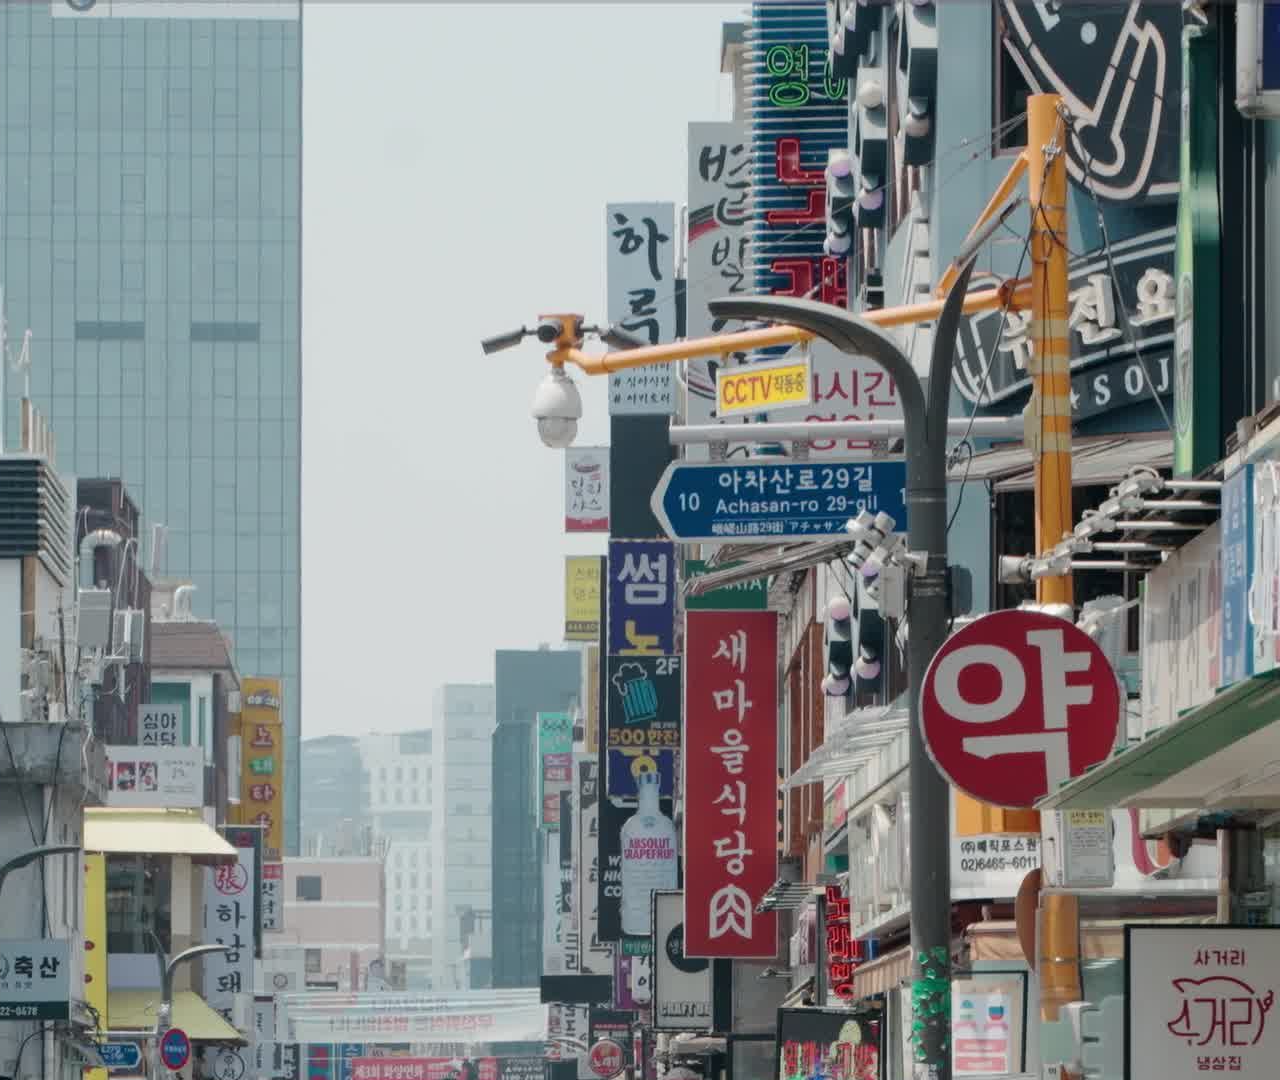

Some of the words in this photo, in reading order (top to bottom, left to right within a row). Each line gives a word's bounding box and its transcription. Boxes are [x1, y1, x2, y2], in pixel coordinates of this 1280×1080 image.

[723, 378, 772, 405] CCTV
[718, 465, 873, 494] 아차산로29길
[679, 492, 700, 512] 10
[715, 498, 819, 515] Achasan-ro
[826, 495, 878, 517] 29-gil
[616, 552, 667, 606] 썸
[655, 658, 680, 675] 2F
[144, 713, 177, 729] 심야
[933, 628, 1094, 799] 약
[608, 728, 645, 745] 500
[708, 629, 753, 876] 새마을식당
[627, 837, 671, 849] ABSOLUT
[14, 955, 61, 979] 축산
[1194, 948, 1247, 968] 사거리
[1196, 1055, 1242, 1072] 냉삼집
